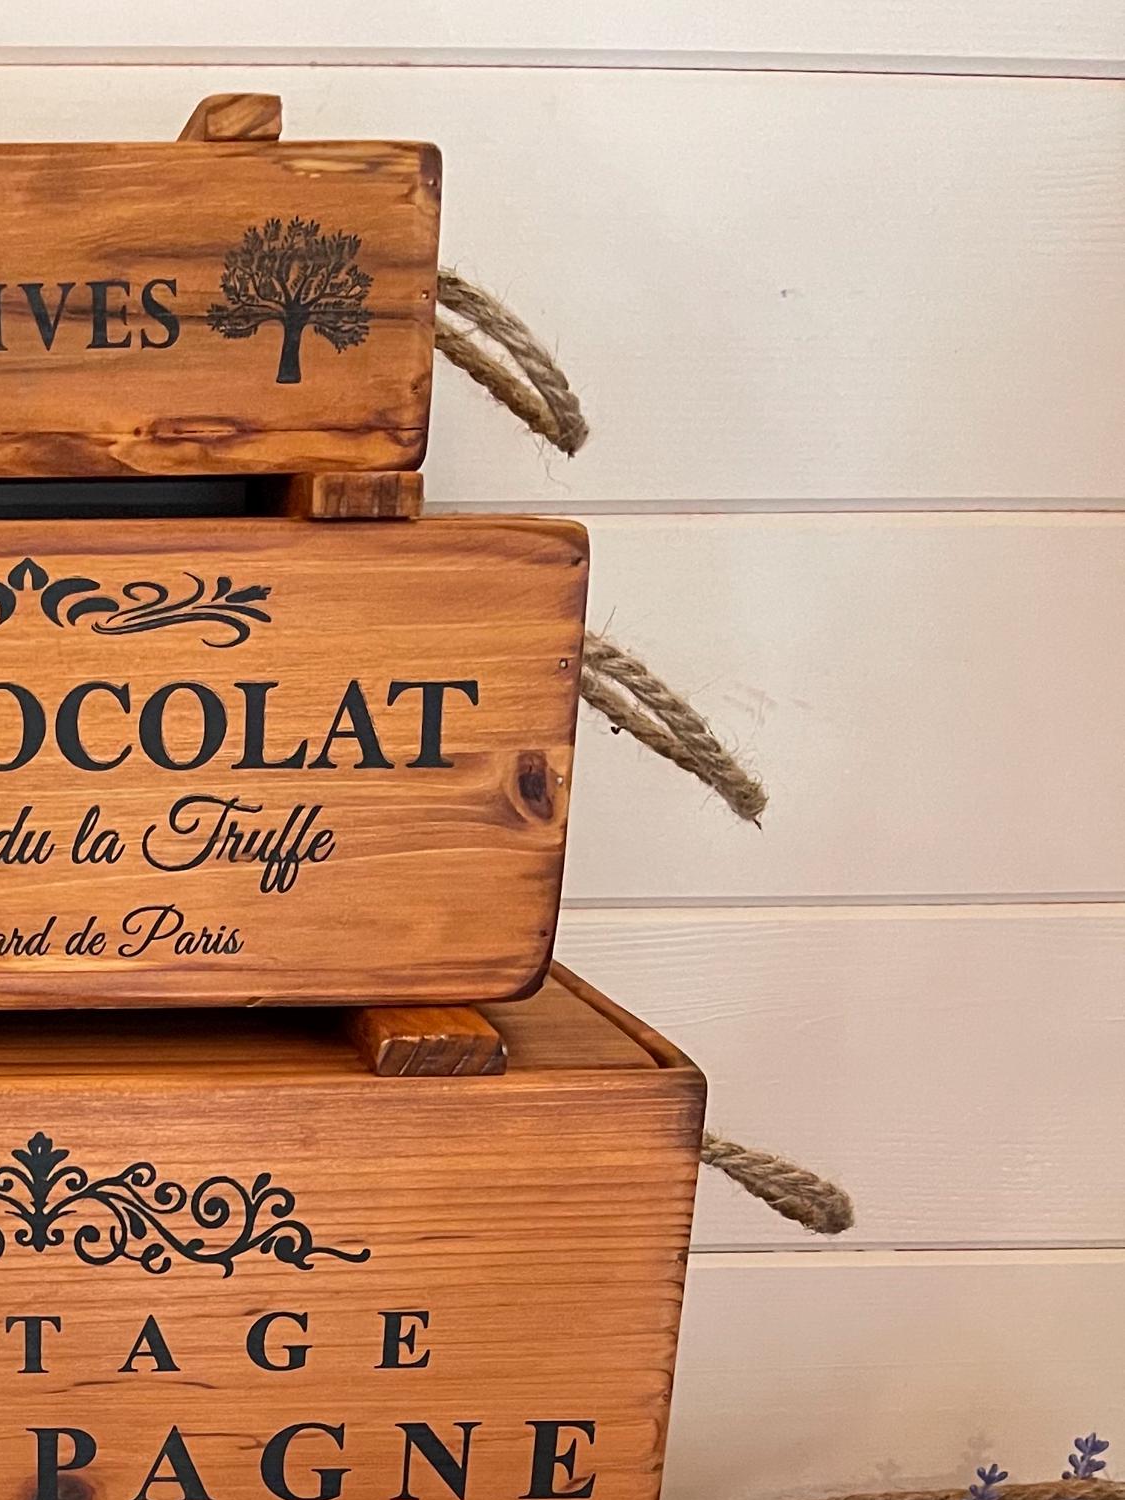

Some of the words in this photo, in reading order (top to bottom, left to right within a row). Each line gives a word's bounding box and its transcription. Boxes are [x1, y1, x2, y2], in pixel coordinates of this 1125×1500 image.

[71, 804, 125, 867] la
[141, 793, 335, 894] Truffe
[63, 908, 107, 958] de
[120, 903, 244, 958] Paris
